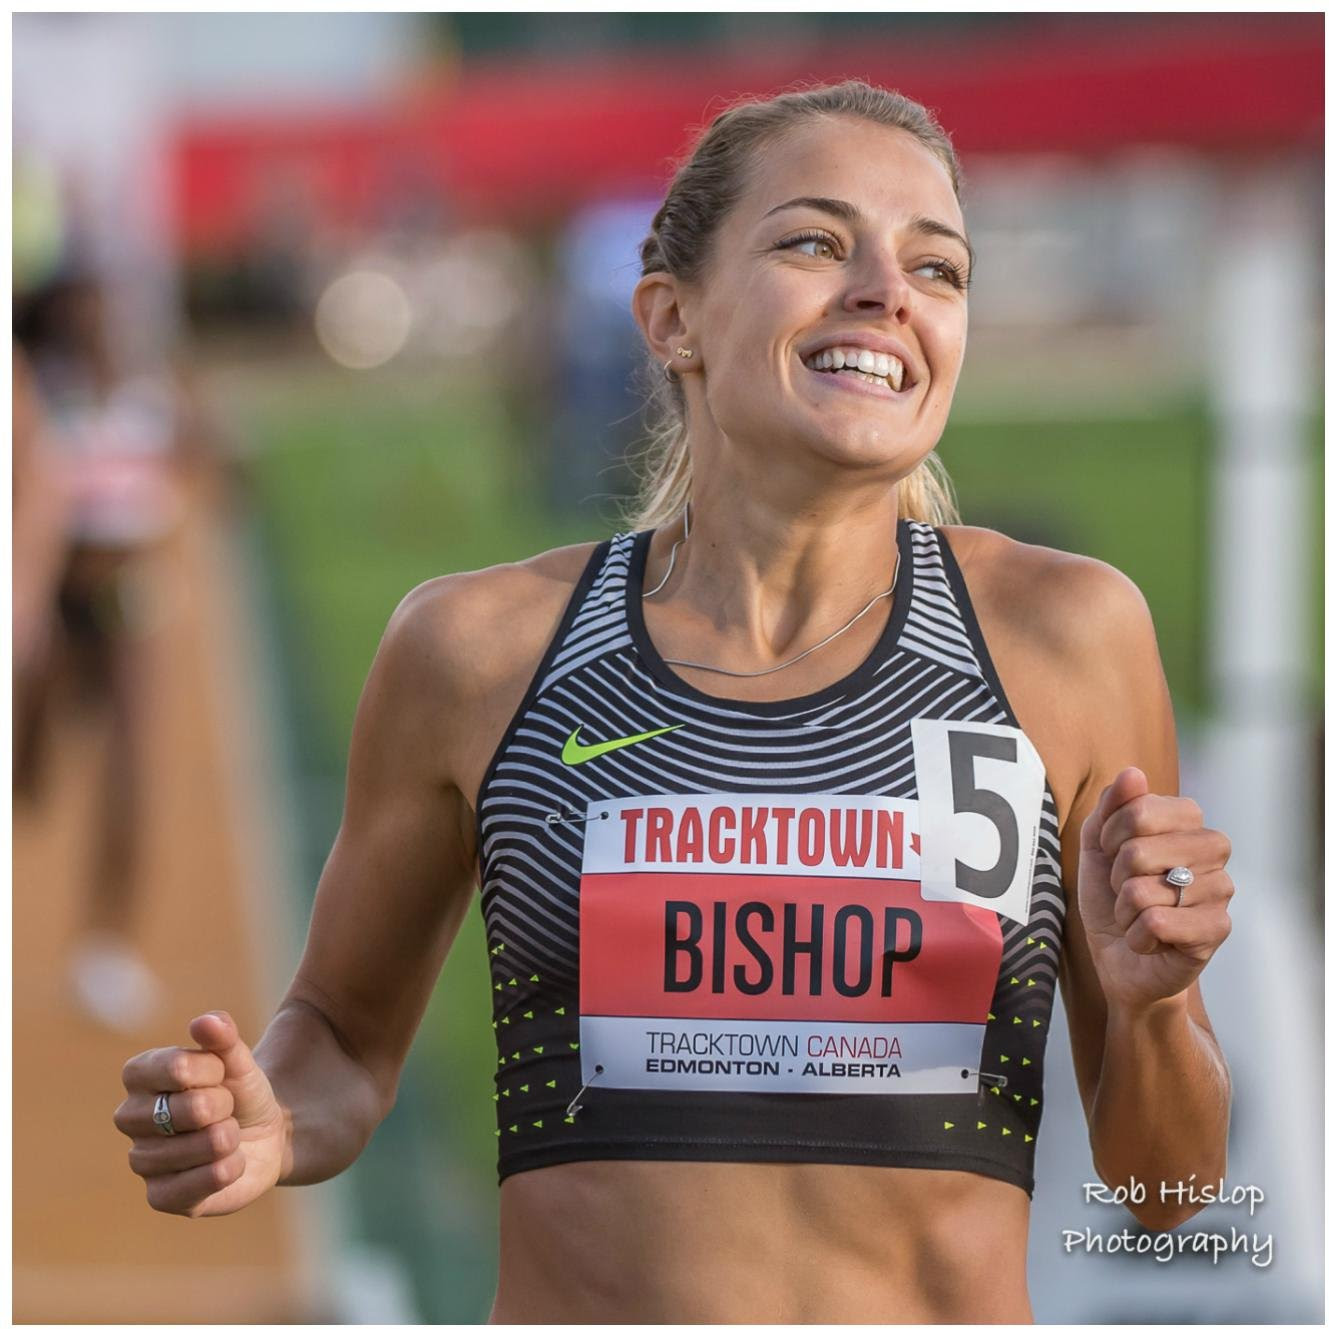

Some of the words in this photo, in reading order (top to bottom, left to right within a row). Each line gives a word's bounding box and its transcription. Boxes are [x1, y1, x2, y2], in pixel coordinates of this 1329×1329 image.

[620, 806, 906, 870] TRACKTOWN
[947, 728, 1020, 900] 5
[663, 899, 924, 1000] BISHOP
[645, 1057, 781, 1077] EDMONTON
[802, 1059, 903, 1079] ALBERTA
[646, 1031, 799, 1057] TRACKTOWN
[807, 1033, 903, 1060] CANADA
